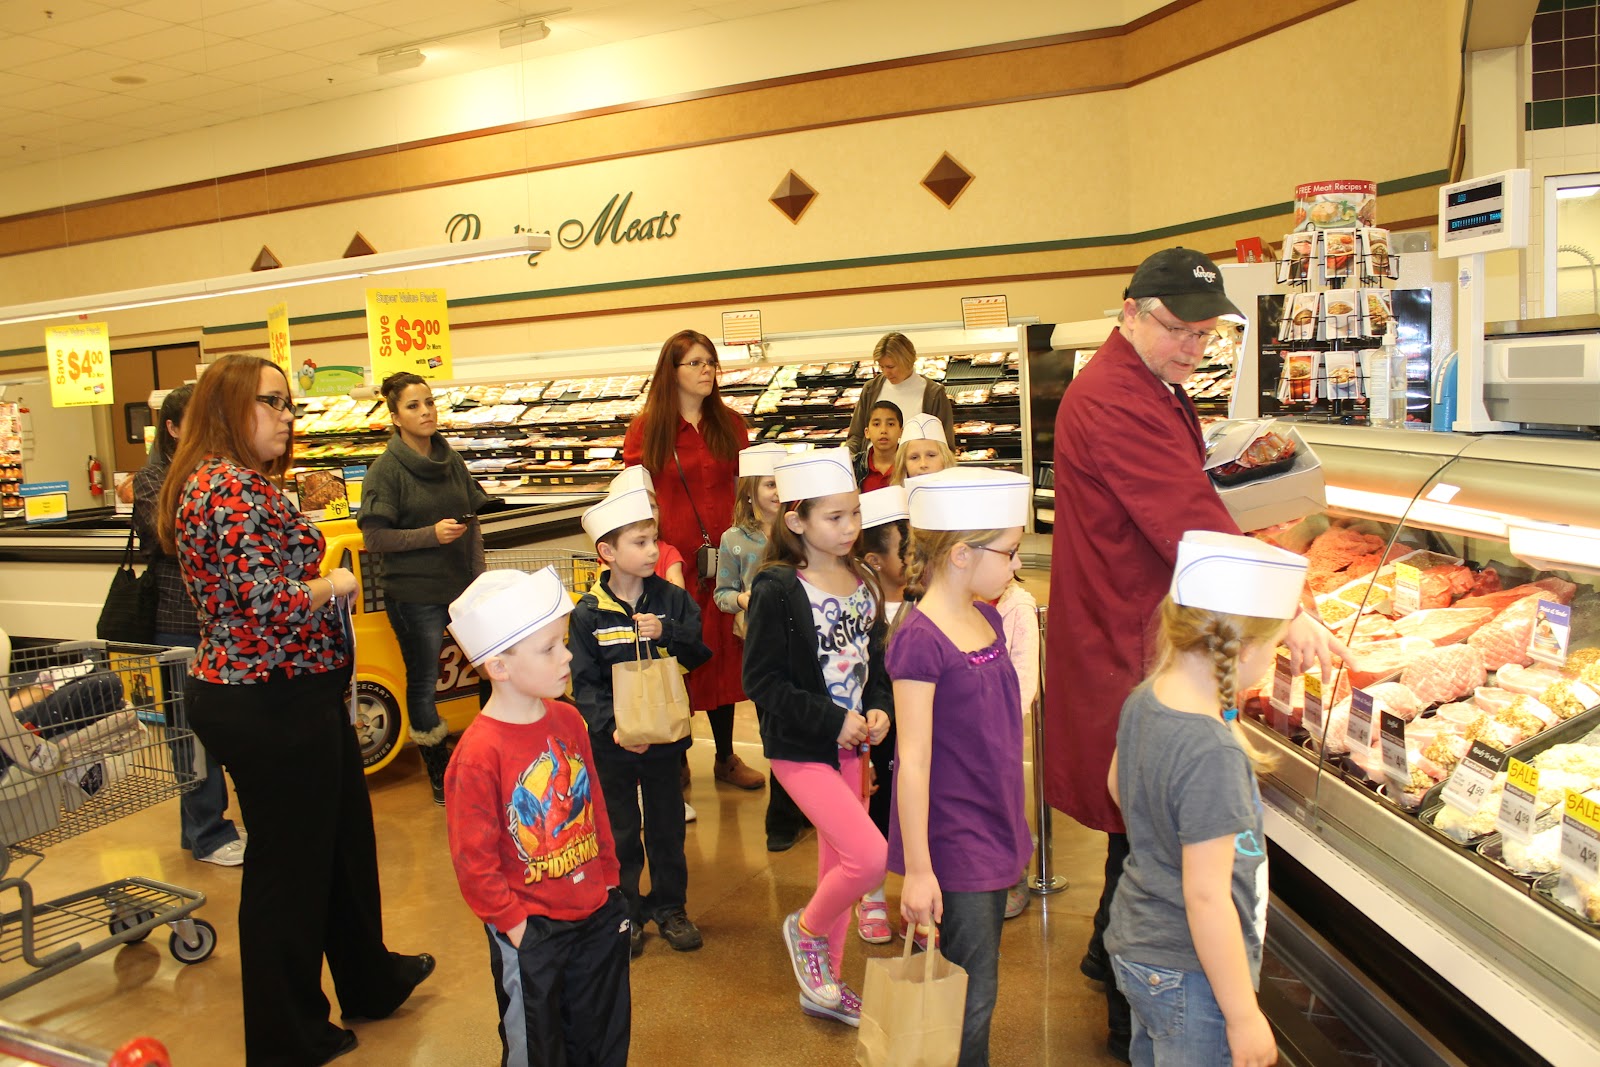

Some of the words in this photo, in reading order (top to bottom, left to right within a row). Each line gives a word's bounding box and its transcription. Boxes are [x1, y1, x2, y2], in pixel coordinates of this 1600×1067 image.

[1299, 186, 1312, 194] FREE
[1313, 184, 1332, 192] Meat
[1334, 183, 1362, 191] Recipes
[557, 191, 681, 249] Meats
[380, 315, 392, 357] Save
[56, 349, 66, 385] Save
[435, 645, 480, 691] 32
[363, 743, 391, 765] SERIES
[1509, 762, 1537, 787] SALE
[1566, 793, 1600, 823] SALE
